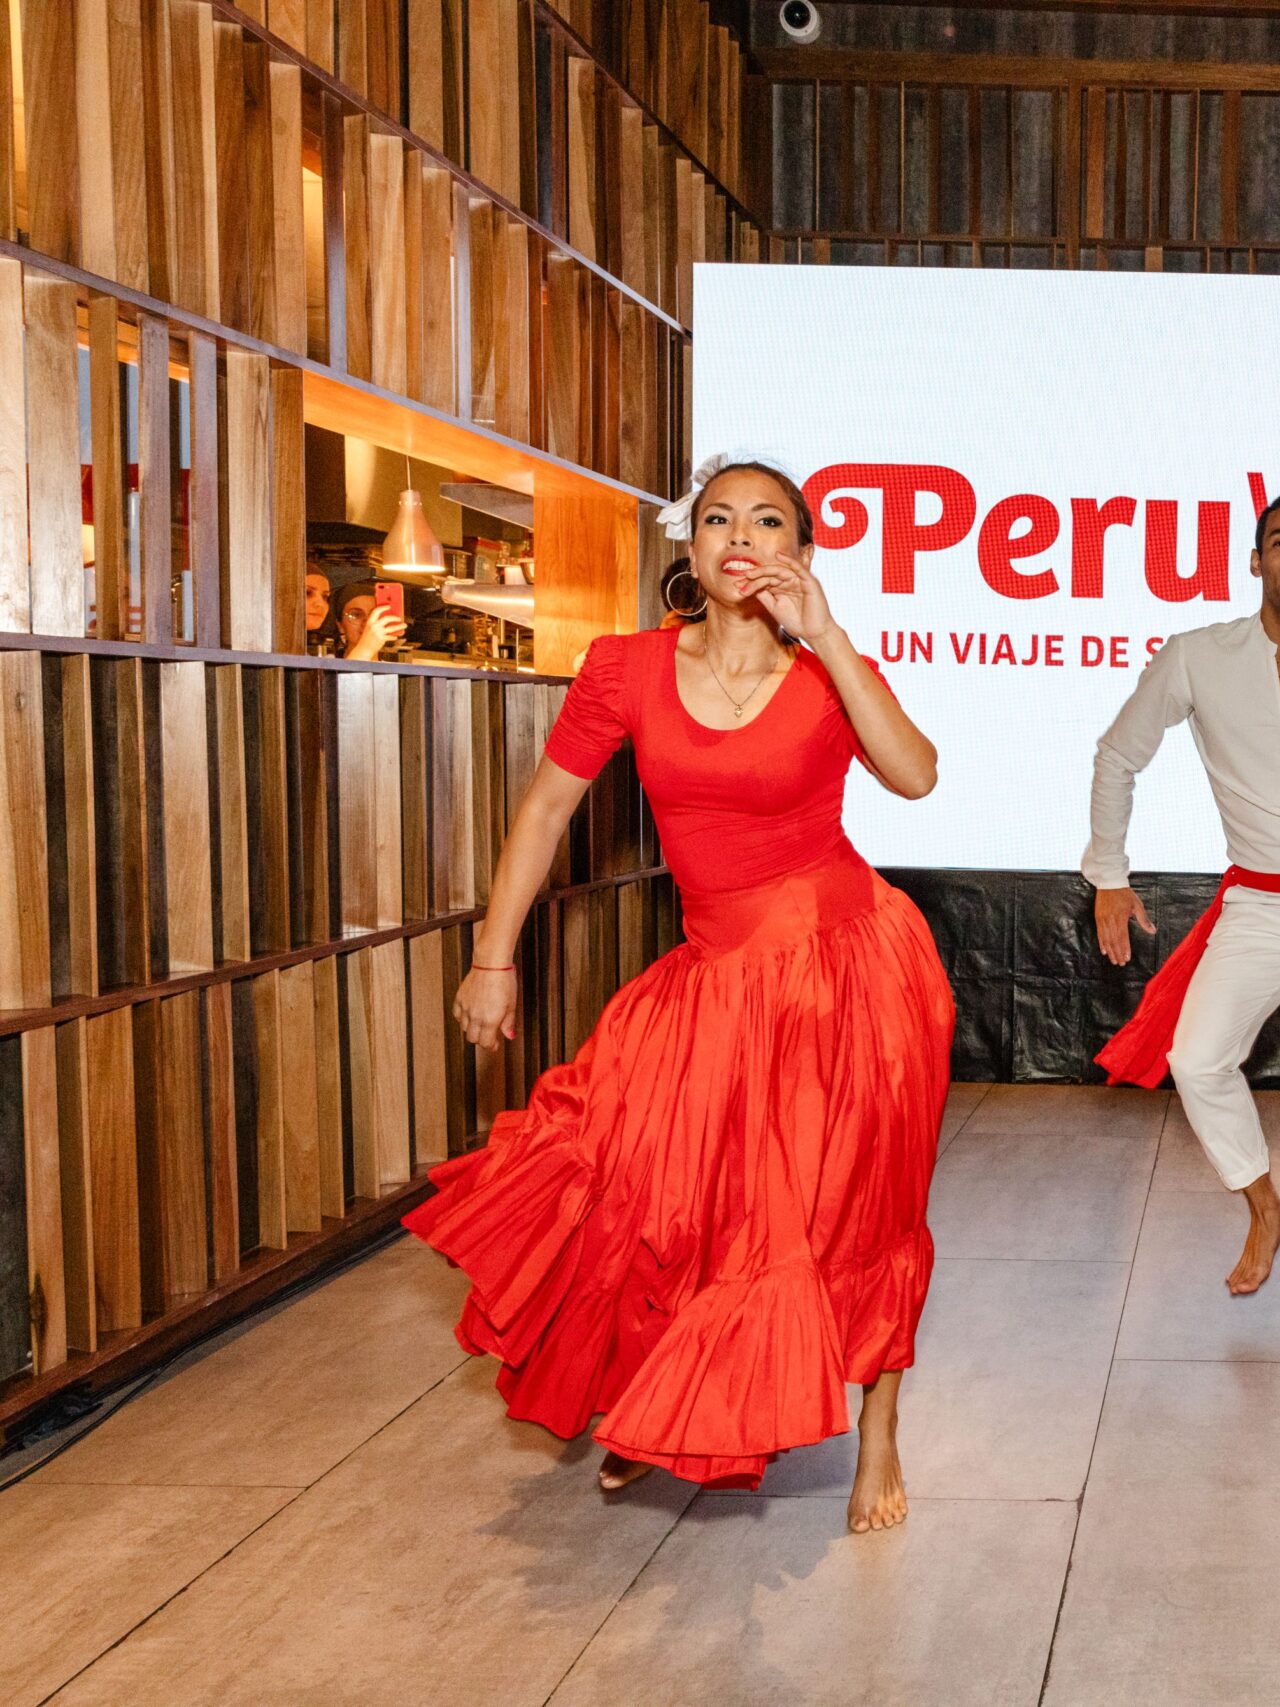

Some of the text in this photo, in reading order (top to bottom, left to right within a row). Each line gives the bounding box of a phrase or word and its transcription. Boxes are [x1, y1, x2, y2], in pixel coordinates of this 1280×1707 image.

[881, 631, 933, 662] UN
[950, 632, 1064, 667] VIAJE
[1081, 635, 1129, 668] DE
